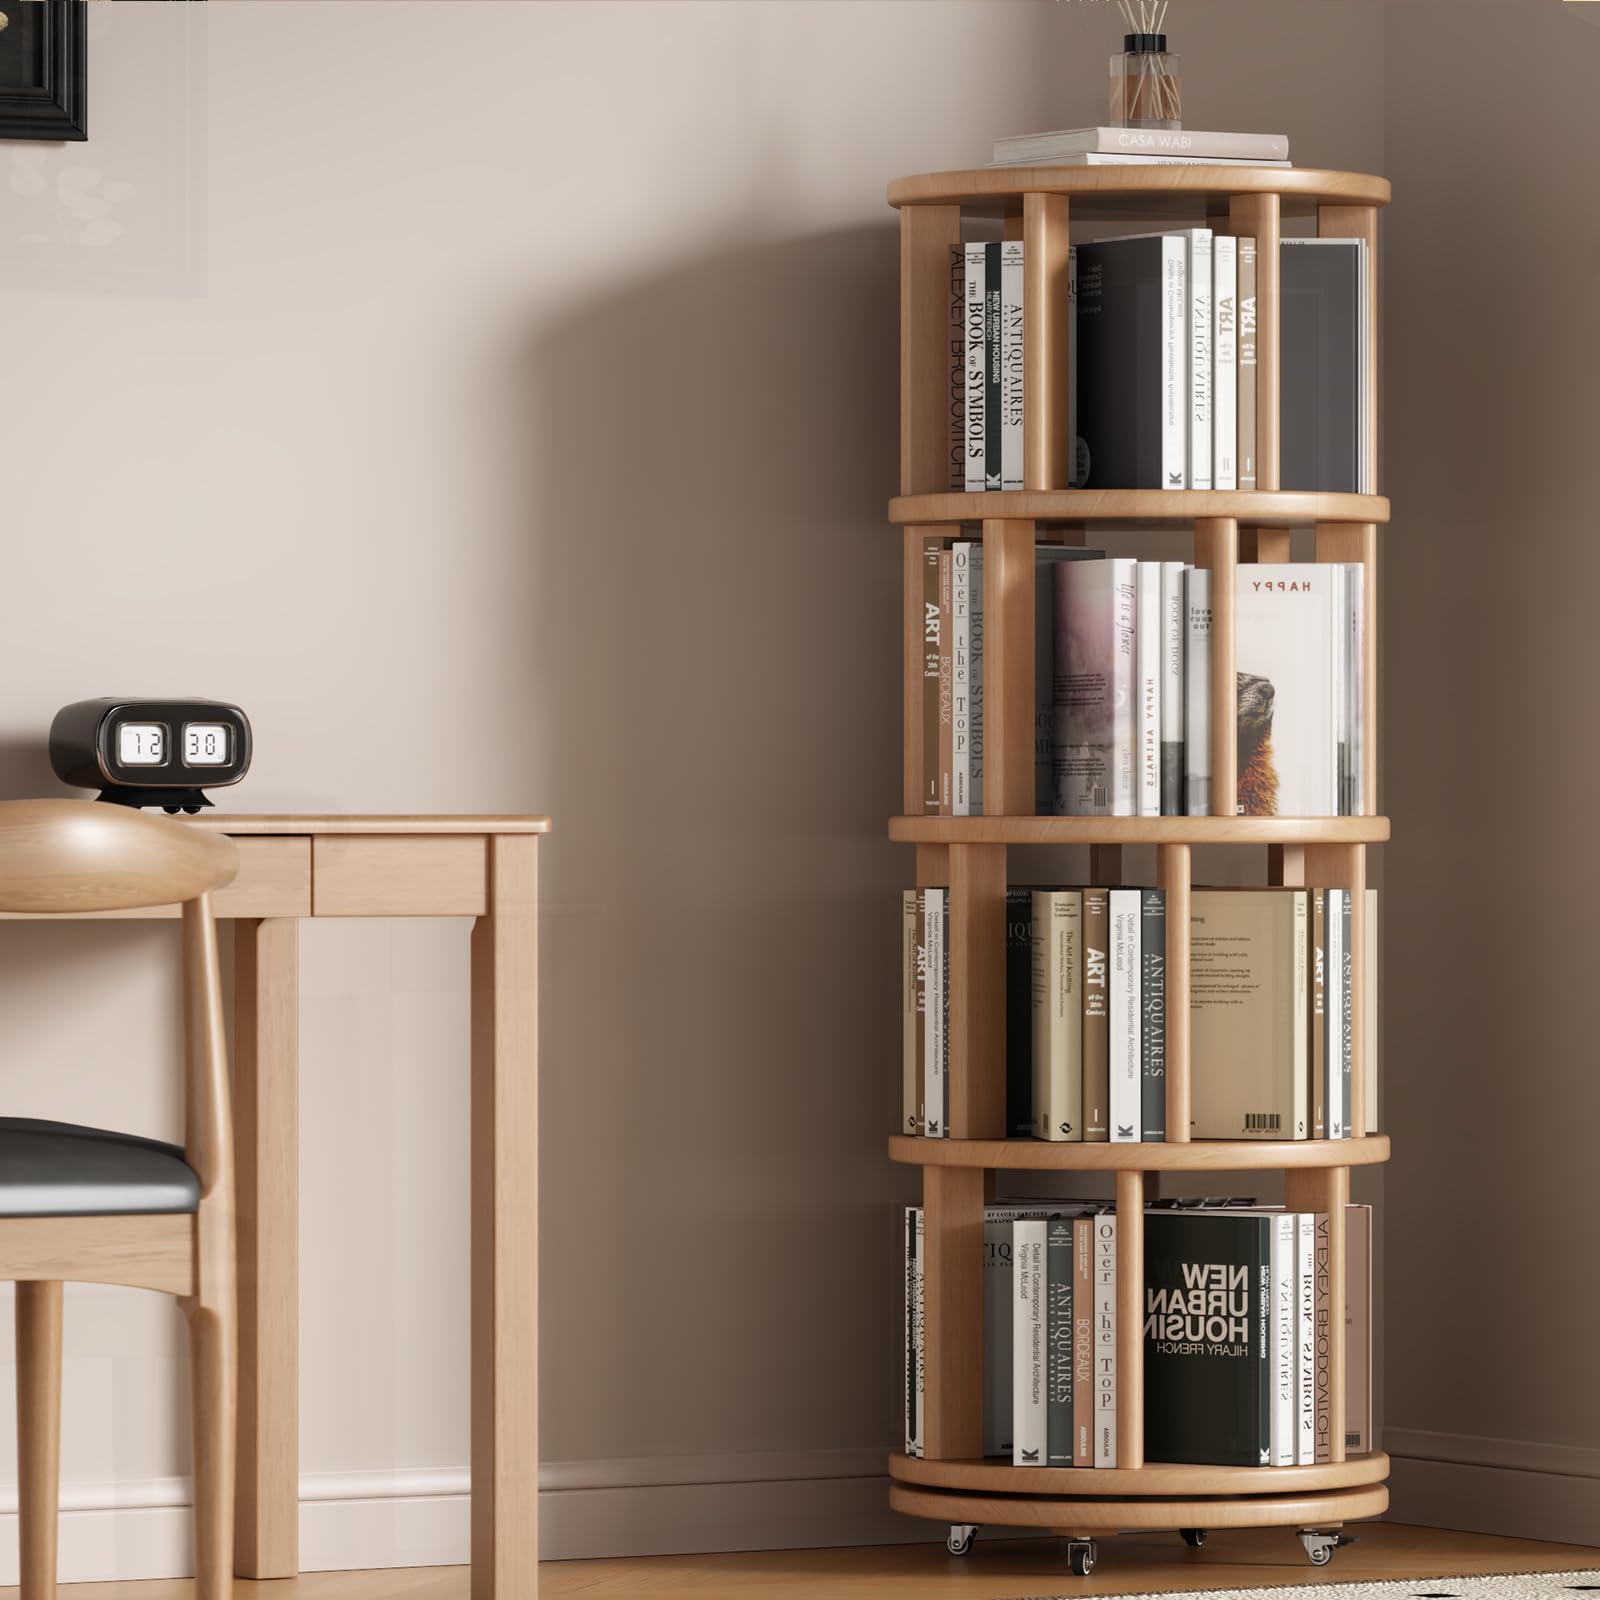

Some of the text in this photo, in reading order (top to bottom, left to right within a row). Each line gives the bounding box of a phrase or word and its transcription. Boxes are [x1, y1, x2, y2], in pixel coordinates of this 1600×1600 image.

[1118, 134, 1192, 150] CASA WABI
[952, 250, 966, 331] ALEXEY
[993, 291, 1001, 384] NEW URBAN HOUSING
[1007, 304, 1023, 426] ANTIQUAIRES
[969, 280, 985, 458] THE BOOK OF SYMBOLS
[925, 602, 940, 646] ART
[955, 552, 967, 751] Over the Top
[971, 611, 983, 665] BOOK
[940, 656, 952, 725] BORDEAUX
[135, 733, 161, 756] 12
[189, 733, 216, 756] 30
[971, 685, 983, 778] SYMBOLS
[1065, 932, 1073, 943] The
[1065, 945, 1073, 956] Art
[1115, 913, 1125, 971] Virginia McLeod
[1126, 913, 1136, 933] Detail
[1064, 966, 1074, 994] Knitting
[1087, 947, 1105, 988] ART
[1126, 943, 1136, 994] Contemporary
[1315, 947, 1324, 986] ART
[1126, 996, 1136, 1035] Residential
[1147, 953, 1164, 1077] ANTIQUAIRES
[1126, 1037, 1136, 1080] Architecture
[1020, 1243, 1029, 1299] Virginia McLeod
[1032, 1243, 1042, 1405] Detail in Contemporary Residential Architecture
[1055, 1283, 1072, 1403] ANTIQUAIRES
[1100, 1224, 1113, 1408] Over the Top
[1077, 1319, 1090, 1382] BORDEAUX
